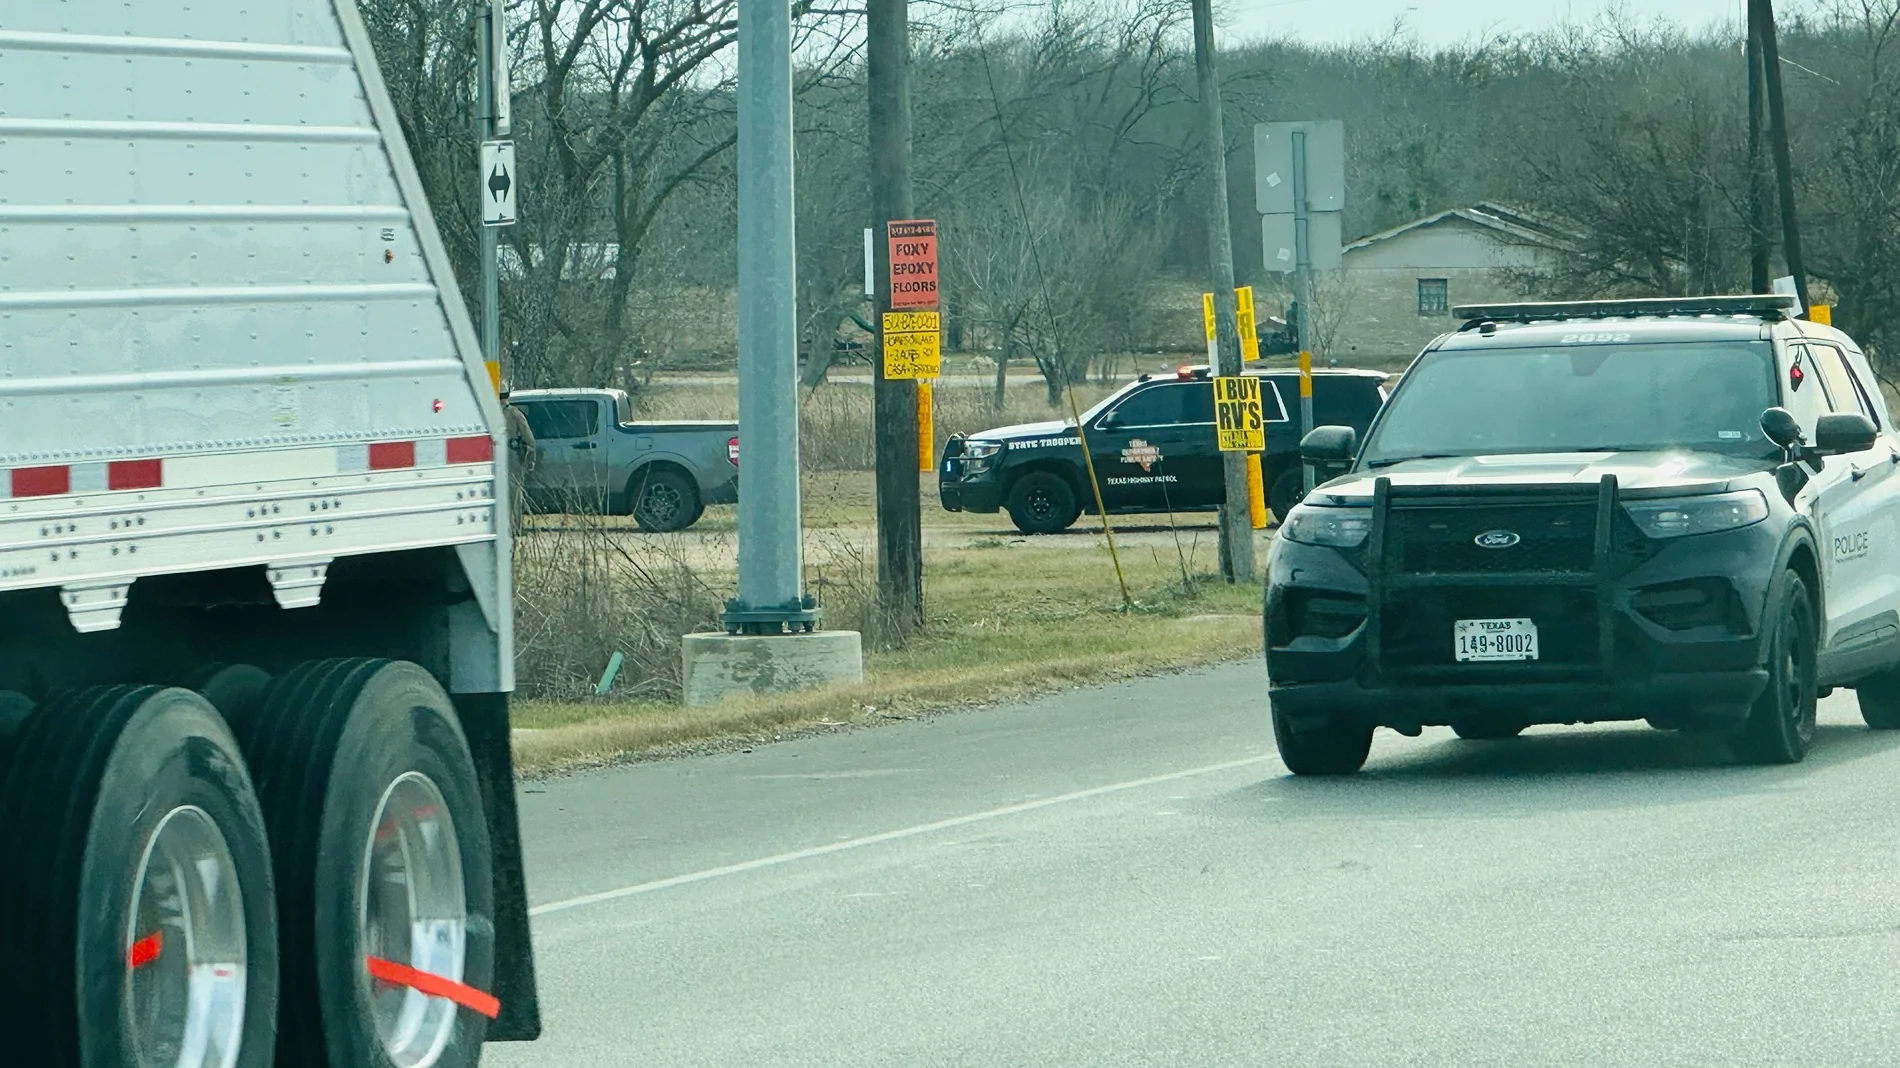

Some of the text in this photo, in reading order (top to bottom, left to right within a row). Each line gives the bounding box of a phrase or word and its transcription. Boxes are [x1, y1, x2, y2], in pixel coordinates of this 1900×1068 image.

[896, 243, 929, 256] FOXY
[893, 262, 934, 275] EPOXY
[893, 281, 937, 293] FLOORS
[1216, 379, 1258, 400] I BUY
[1218, 401, 1261, 430] RV'S
[1008, 436, 1082, 450] STATE TROOPER
[1834, 531, 1868, 557] POLICE
[1479, 621, 1511, 630] TEXAS
